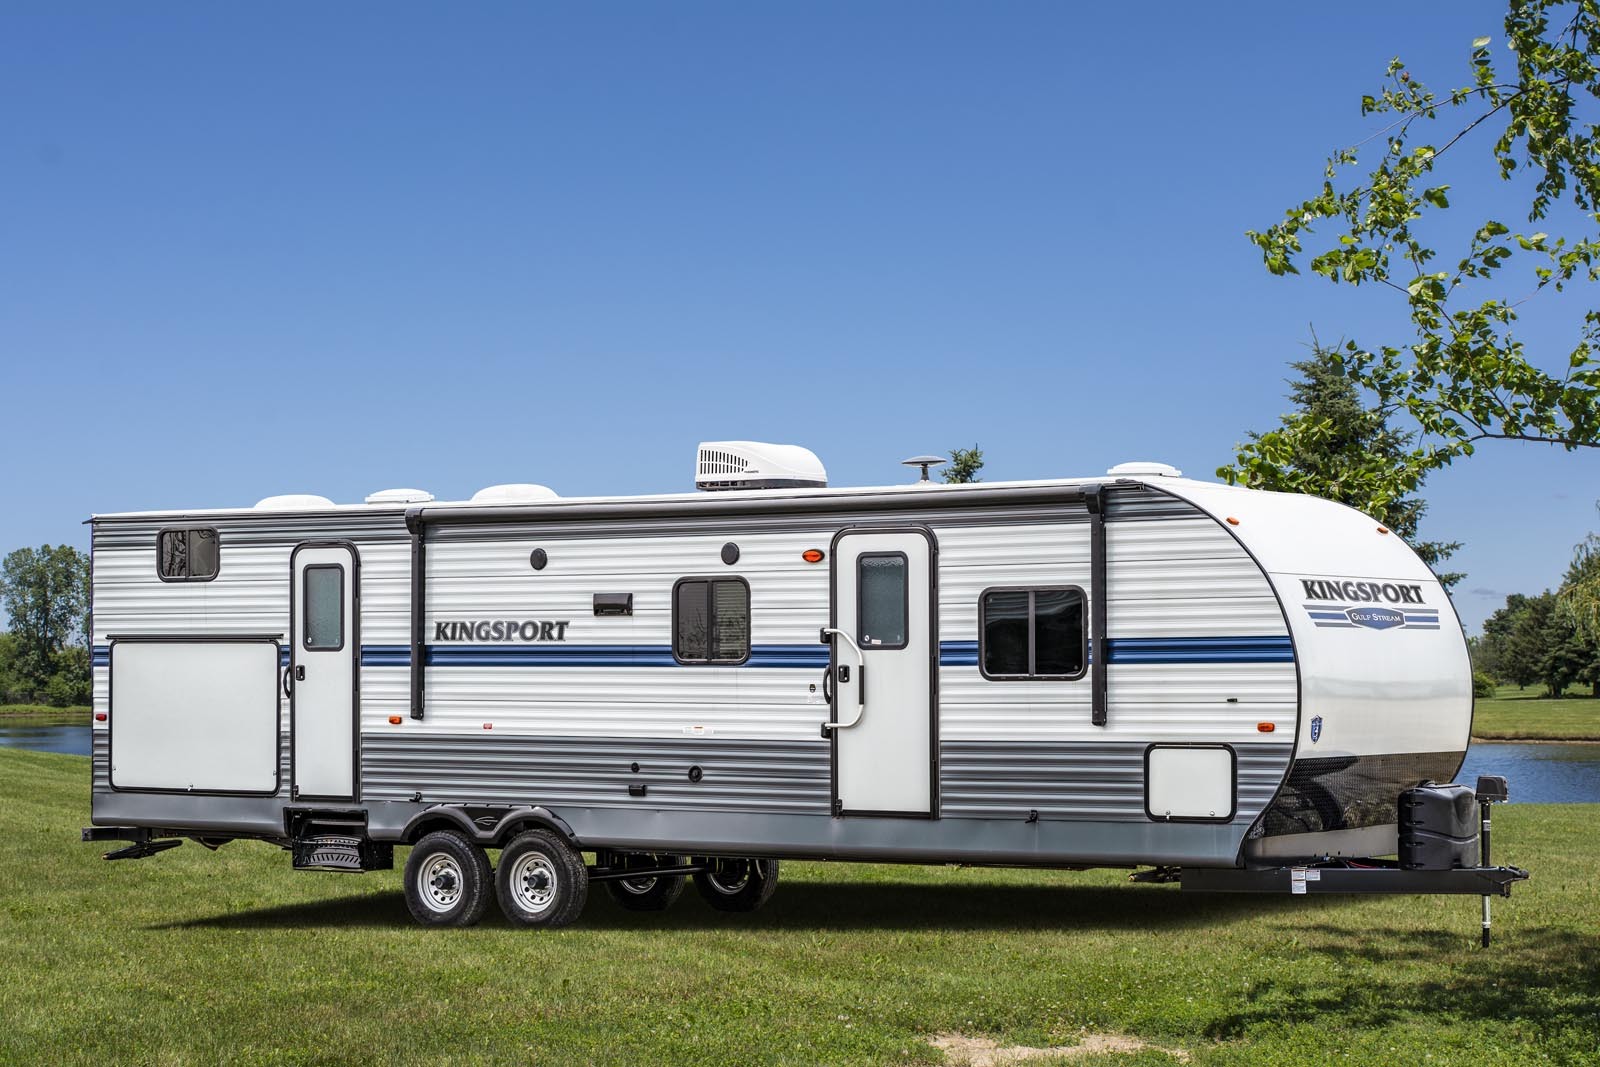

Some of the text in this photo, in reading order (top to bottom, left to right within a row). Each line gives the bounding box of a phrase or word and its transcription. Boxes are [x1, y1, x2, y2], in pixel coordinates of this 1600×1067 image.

[1299, 579, 1426, 604] KINGSPORT
[1351, 612, 1401, 622] GULF STREAM
[432, 620, 570, 642] KINGSPORT
